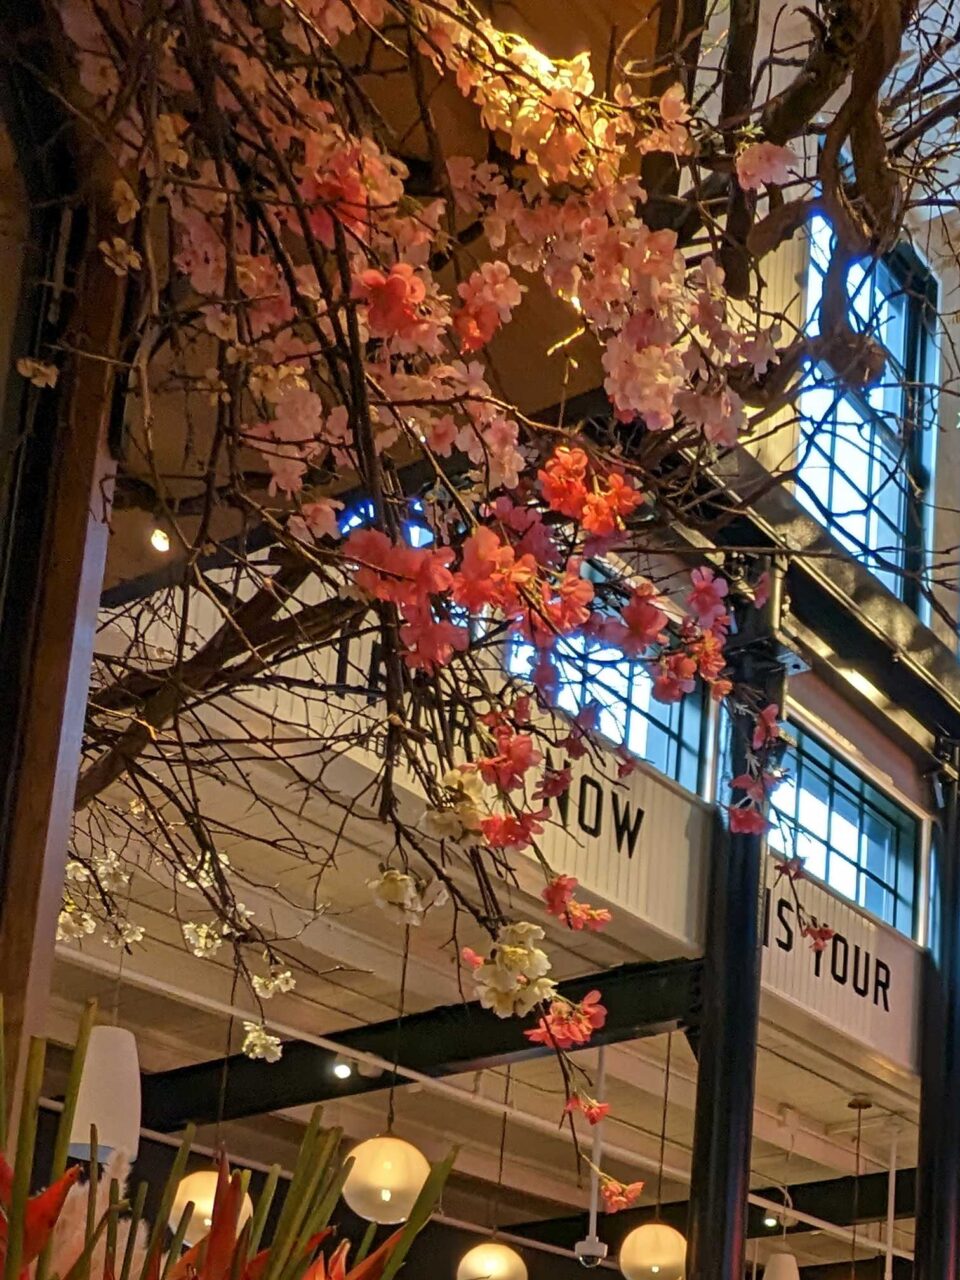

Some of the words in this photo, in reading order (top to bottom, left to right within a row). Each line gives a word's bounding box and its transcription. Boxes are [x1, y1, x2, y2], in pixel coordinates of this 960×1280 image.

[546, 746, 645, 860] NOW
[763, 887, 795, 953] IS
[809, 914, 891, 1013] YOUR
